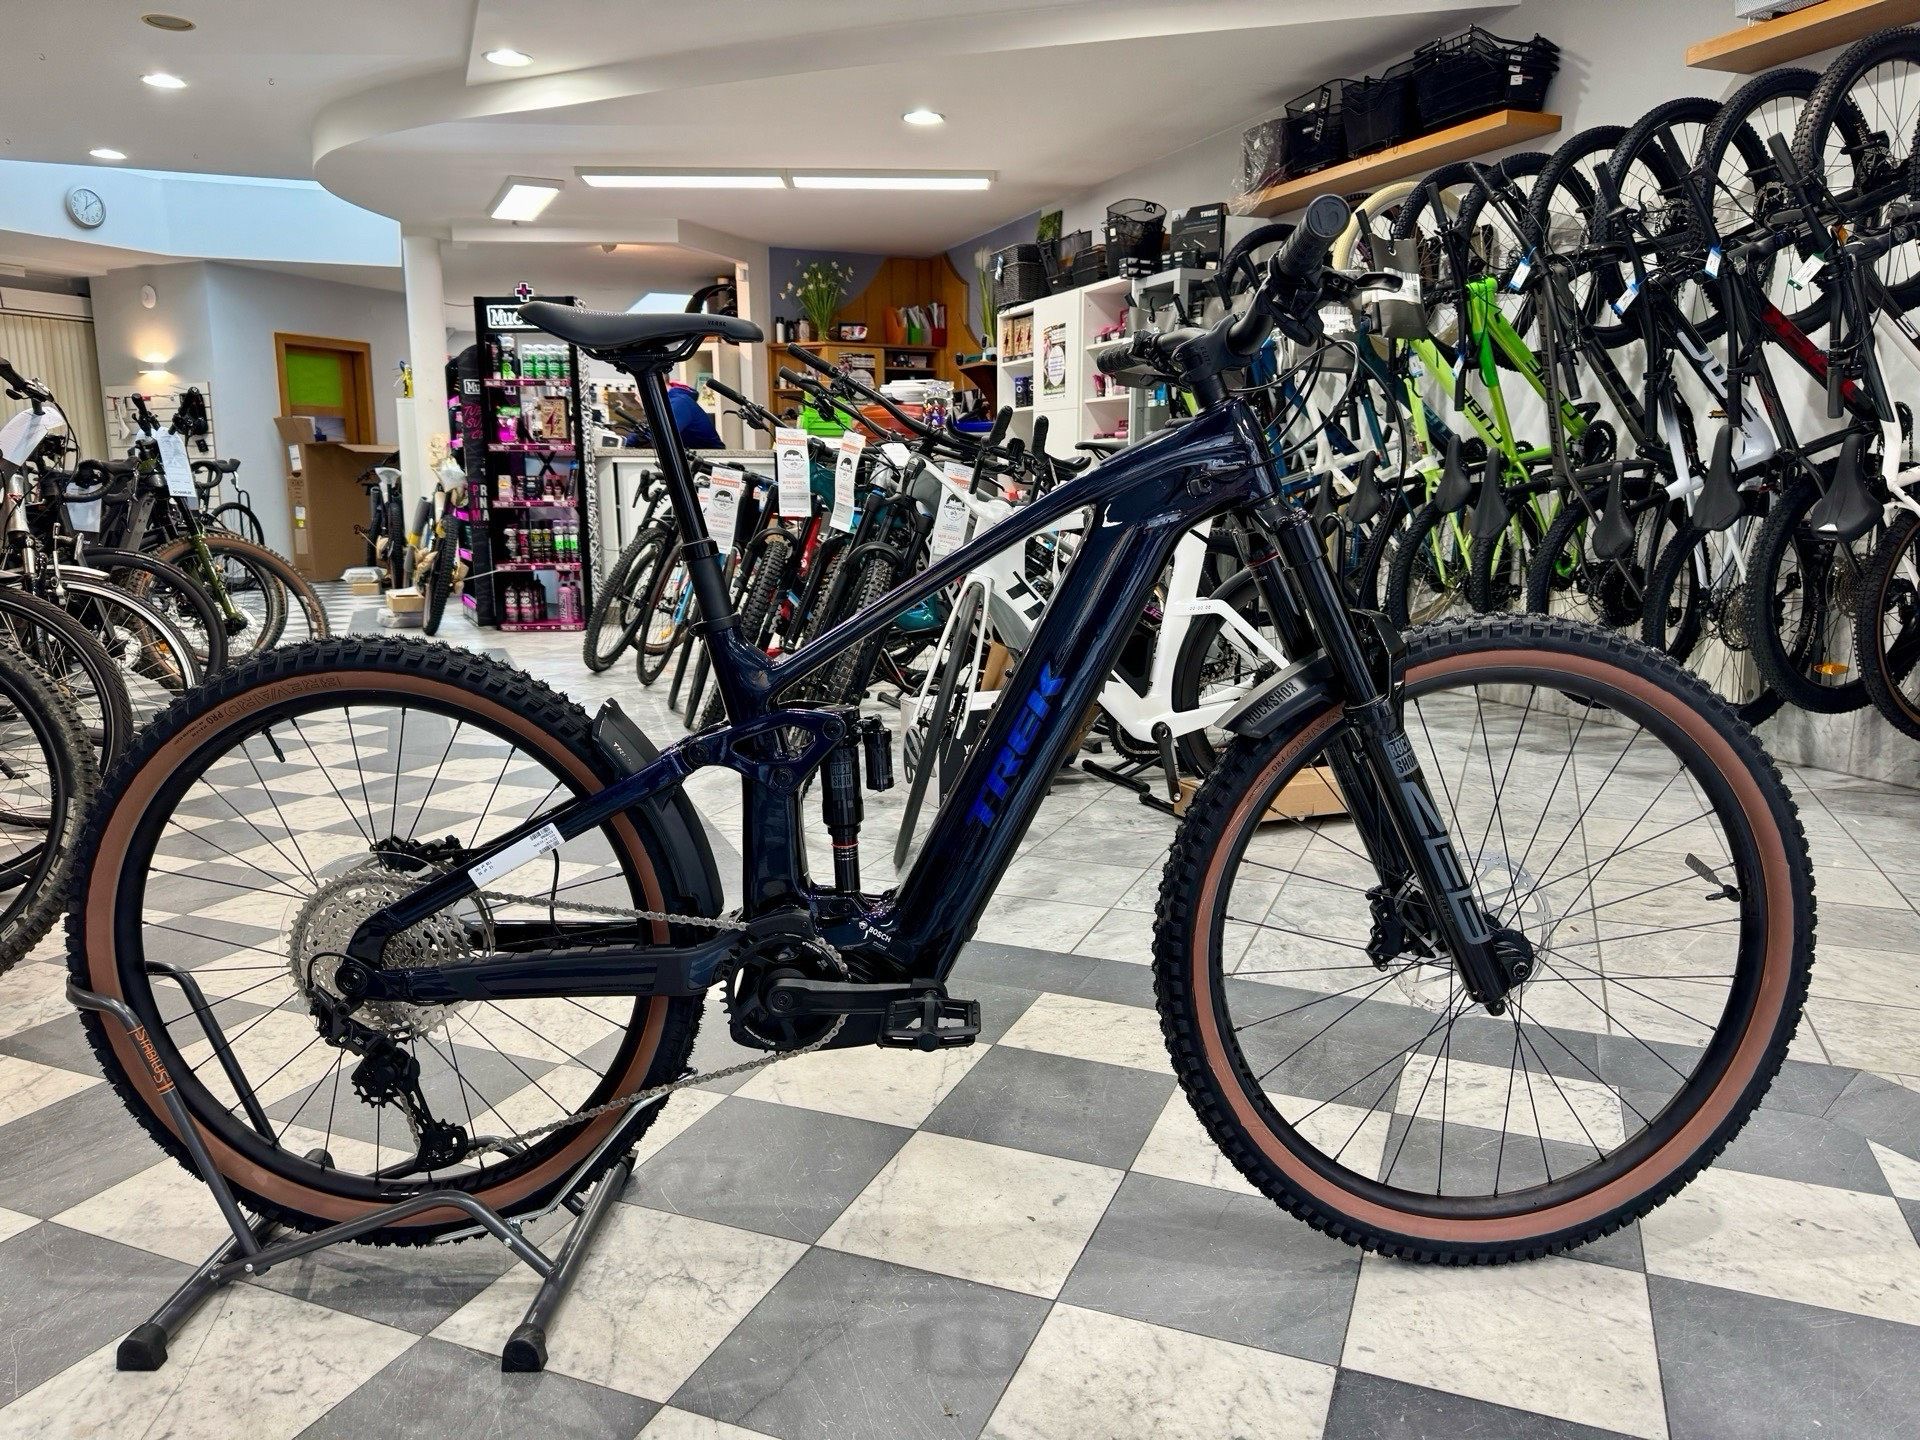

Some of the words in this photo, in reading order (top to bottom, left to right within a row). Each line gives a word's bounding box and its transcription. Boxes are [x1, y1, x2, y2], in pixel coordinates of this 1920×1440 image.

[1200, 209, 1218, 218] THULE
[206, 711, 225, 725] PRO
[1244, 681, 1299, 725] ROCKSHOX
[965, 660, 1066, 828] TREK
[868, 925, 892, 943] BOSCH
[134, 1028, 173, 1085] STABILUS
